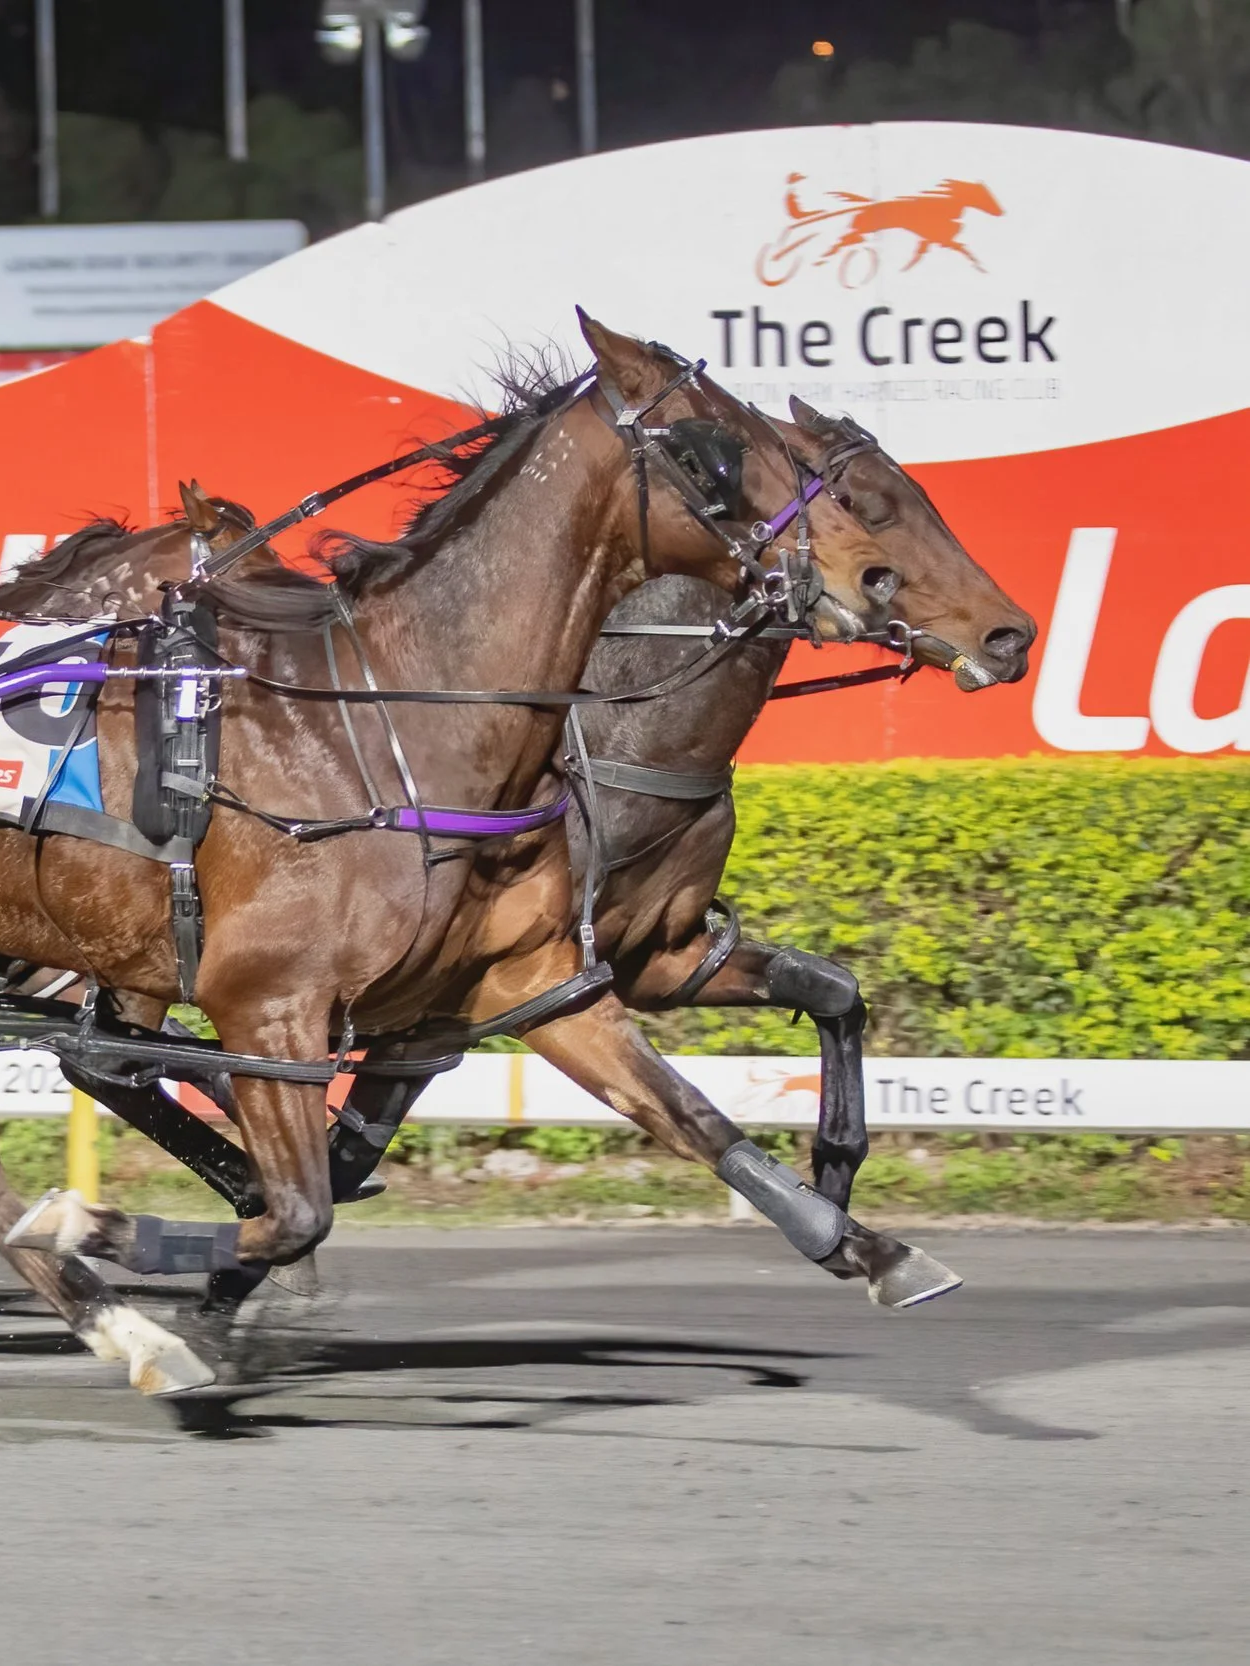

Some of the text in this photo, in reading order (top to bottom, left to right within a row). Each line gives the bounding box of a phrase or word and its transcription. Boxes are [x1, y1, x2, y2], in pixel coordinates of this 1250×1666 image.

[711, 300, 1058, 367] The Creek
[877, 1078, 1084, 1117] The Creek
